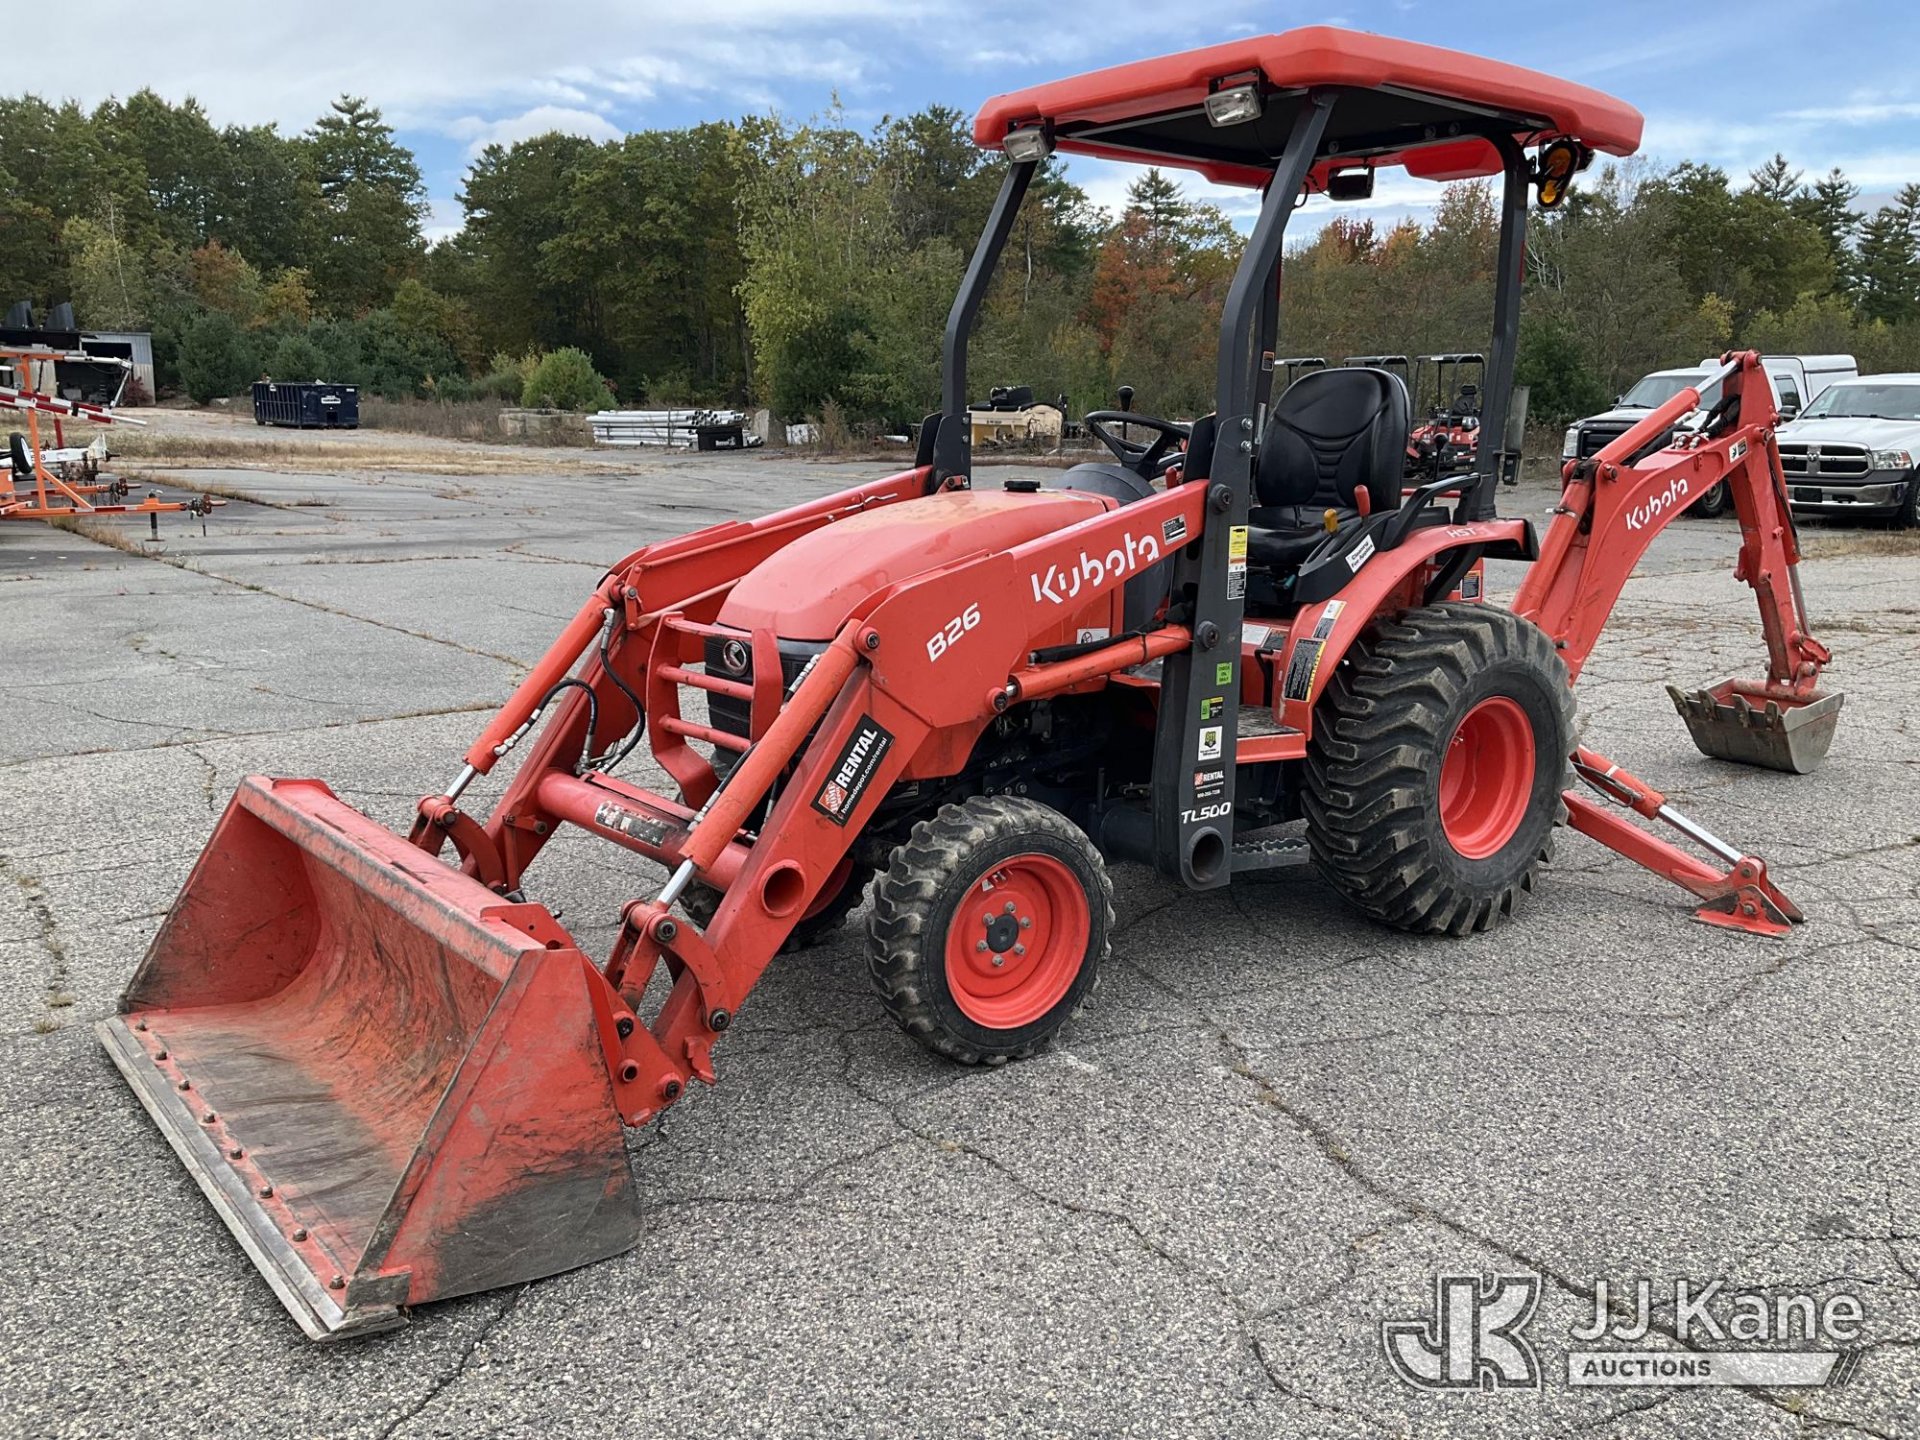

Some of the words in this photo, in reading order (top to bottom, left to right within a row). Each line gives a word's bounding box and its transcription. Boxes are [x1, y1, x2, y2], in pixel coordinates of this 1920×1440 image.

[1625, 478, 1689, 530] Kubota
[1446, 527, 1477, 538] HST
[1030, 532, 1160, 604] Kubota
[926, 601, 981, 663] B26
[835, 728, 877, 788] RENTAL
[841, 738, 887, 813] homedepot.com/rental
[1203, 770, 1224, 782] RENTAL
[1181, 801, 1232, 824] TL500
